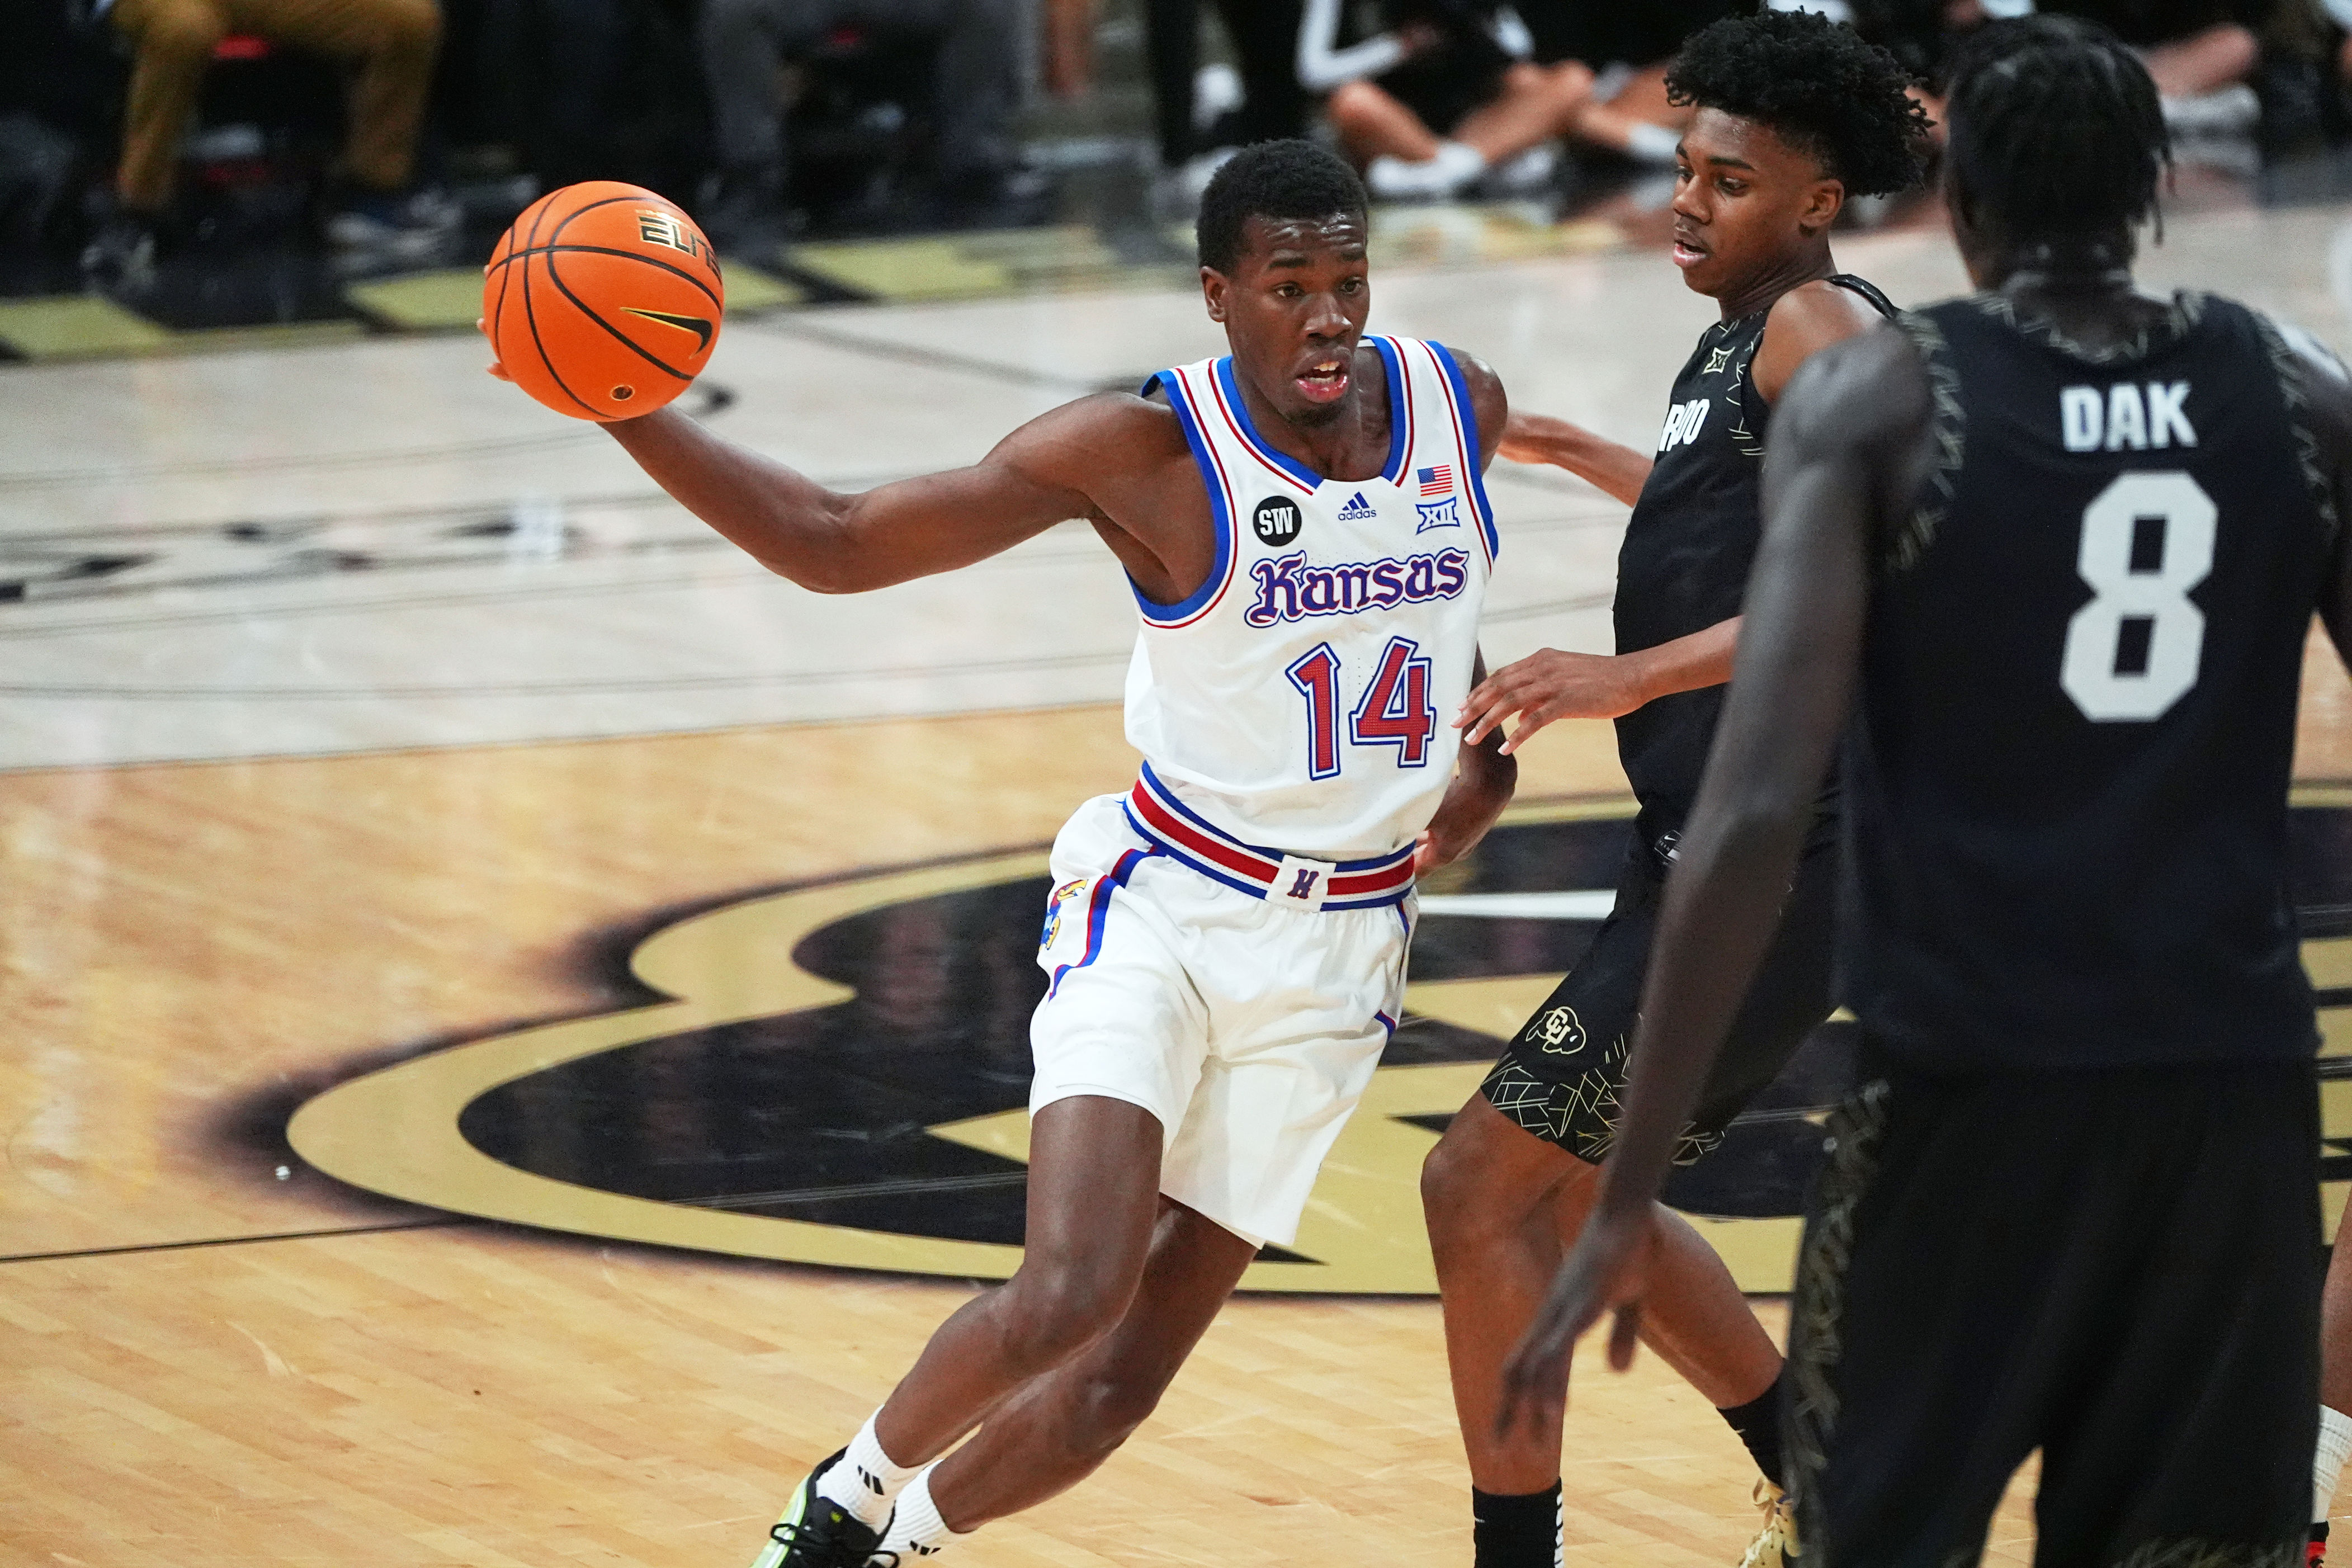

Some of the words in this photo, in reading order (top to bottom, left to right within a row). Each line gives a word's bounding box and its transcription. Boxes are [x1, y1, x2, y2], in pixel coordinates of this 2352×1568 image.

[2060, 380, 2198, 452] DAK
[1259, 507, 1294, 535] SW
[1338, 509, 1377, 521] adidas
[1245, 547, 1470, 627] Kansas
[2060, 469, 2218, 724] 8
[1286, 636, 1436, 781] 14
